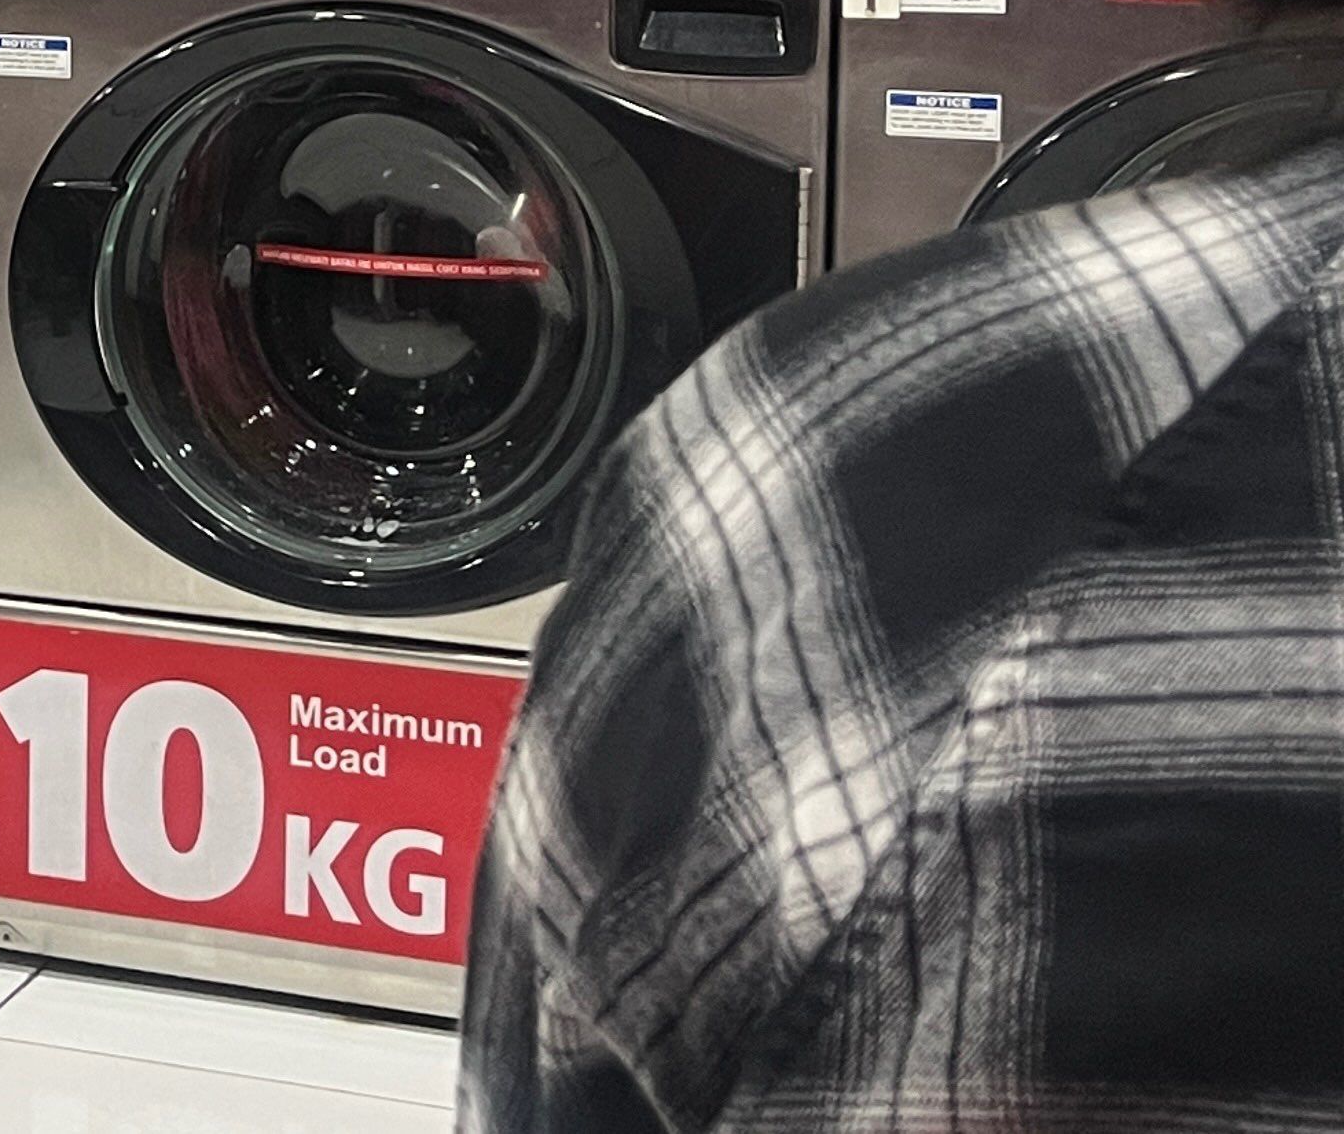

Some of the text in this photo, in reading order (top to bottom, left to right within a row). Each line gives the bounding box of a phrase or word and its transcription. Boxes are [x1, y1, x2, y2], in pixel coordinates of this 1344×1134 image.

[915, 95, 971, 109] NOTICE
[290, 694, 483, 748] Maximum
[289, 735, 387, 778] Load
[284, 814, 446, 935] KG
